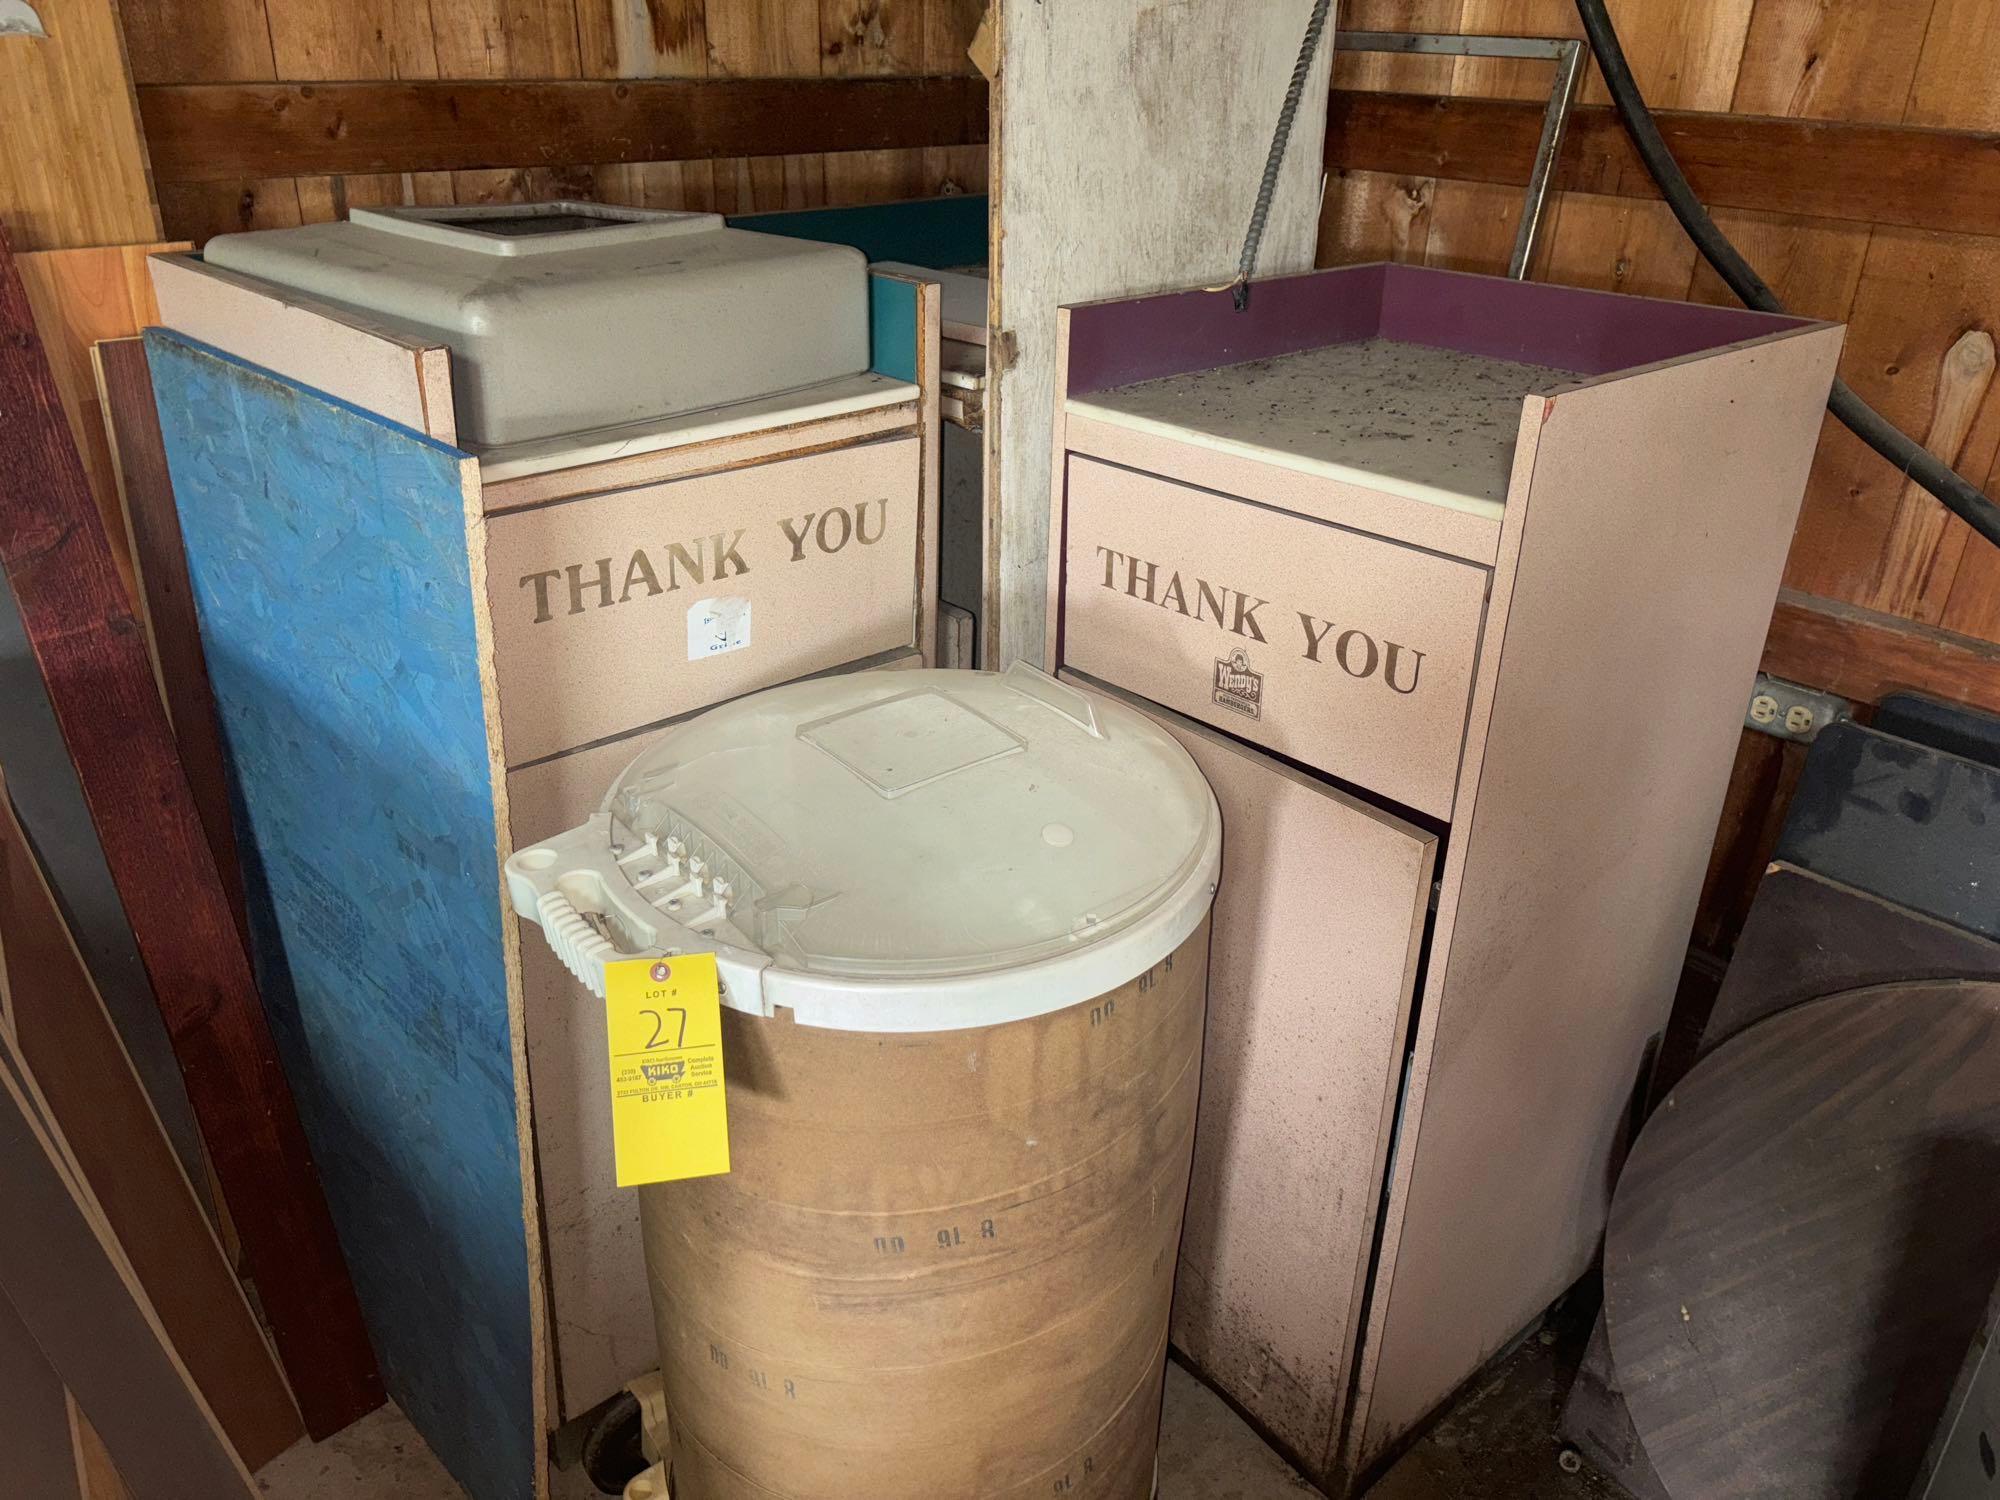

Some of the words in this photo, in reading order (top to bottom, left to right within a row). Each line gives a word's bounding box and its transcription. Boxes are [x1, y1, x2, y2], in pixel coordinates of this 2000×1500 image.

[519, 528, 750, 625] THANK
[777, 498, 888, 562] YOU
[1096, 546, 1270, 644] THANK
[1296, 611, 1427, 695] YOU
[646, 990, 666, 999] LOT
[640, 1008, 687, 1049] 27
[647, 1064, 680, 1077] KIKO
[642, 1091, 682, 1103] BUYER
